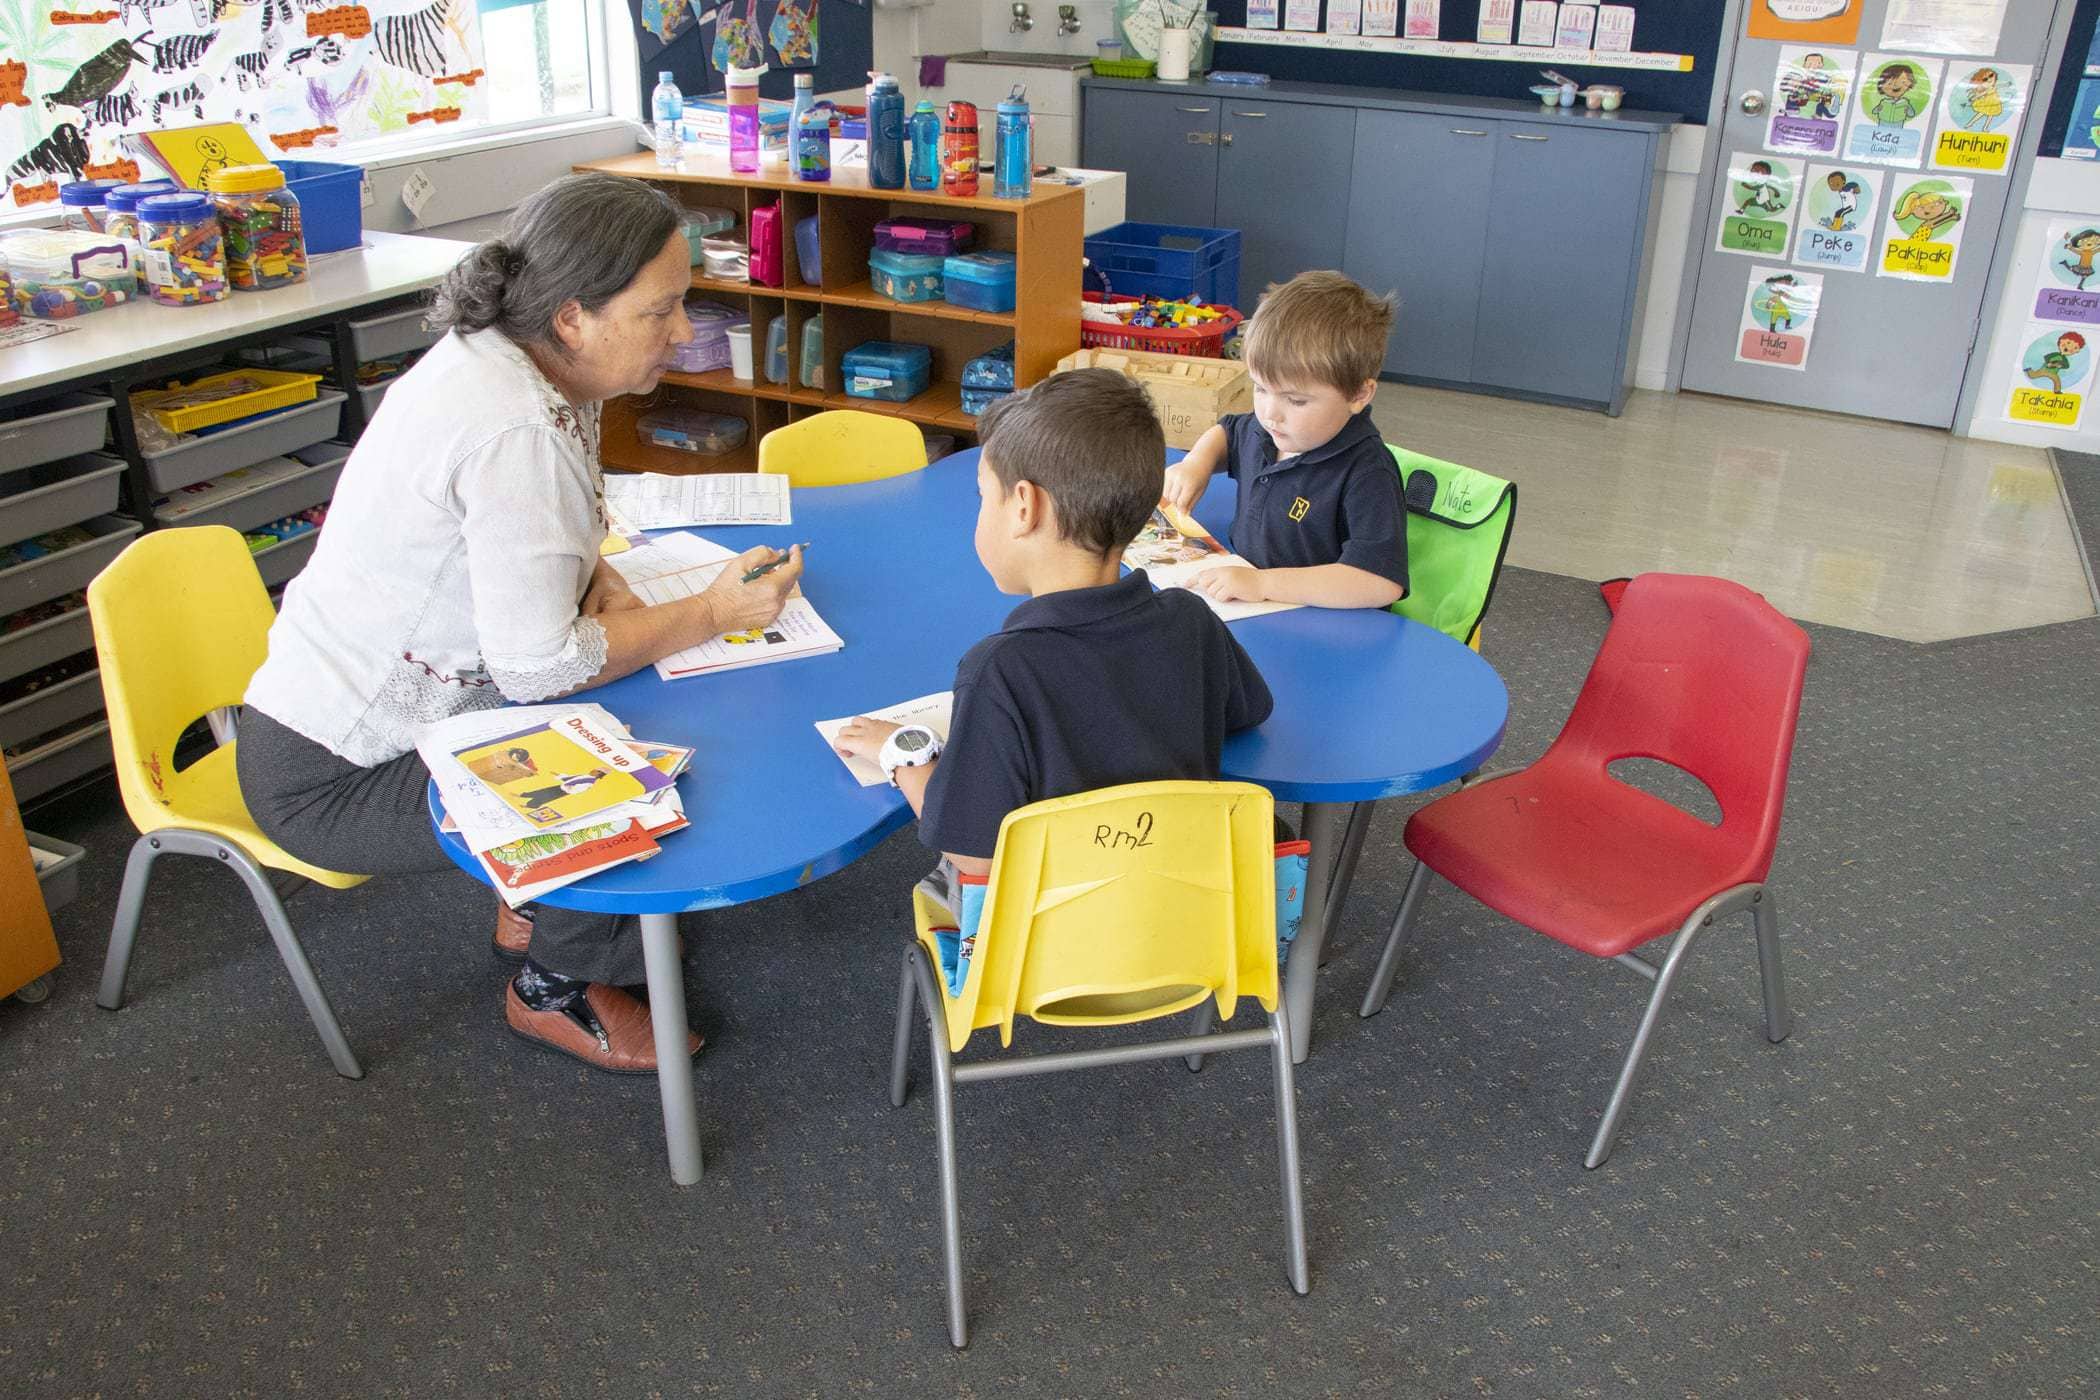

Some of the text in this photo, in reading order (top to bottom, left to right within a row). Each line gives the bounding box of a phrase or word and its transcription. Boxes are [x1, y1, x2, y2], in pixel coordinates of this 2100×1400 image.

[1218, 31, 1675, 66] January February March April May June July August September October November December
[1871, 130, 1900, 144] Kata
[1939, 132, 2008, 154] Hurihuri
[1738, 222, 1773, 241] Oma
[1811, 233, 1854, 252] Peke
[1886, 243, 1953, 266] Pakipaki
[2047, 293, 2099, 309] Kanikani
[1760, 334, 1788, 350] Hula
[2021, 392, 2075, 411] Takahia
[1162, 404, 1192, 434] llege
[1442, 481, 1472, 514] Nate
[566, 717, 631, 767] Dressing up
[597, 832, 641, 851] Spots
[566, 846, 594, 861] and
